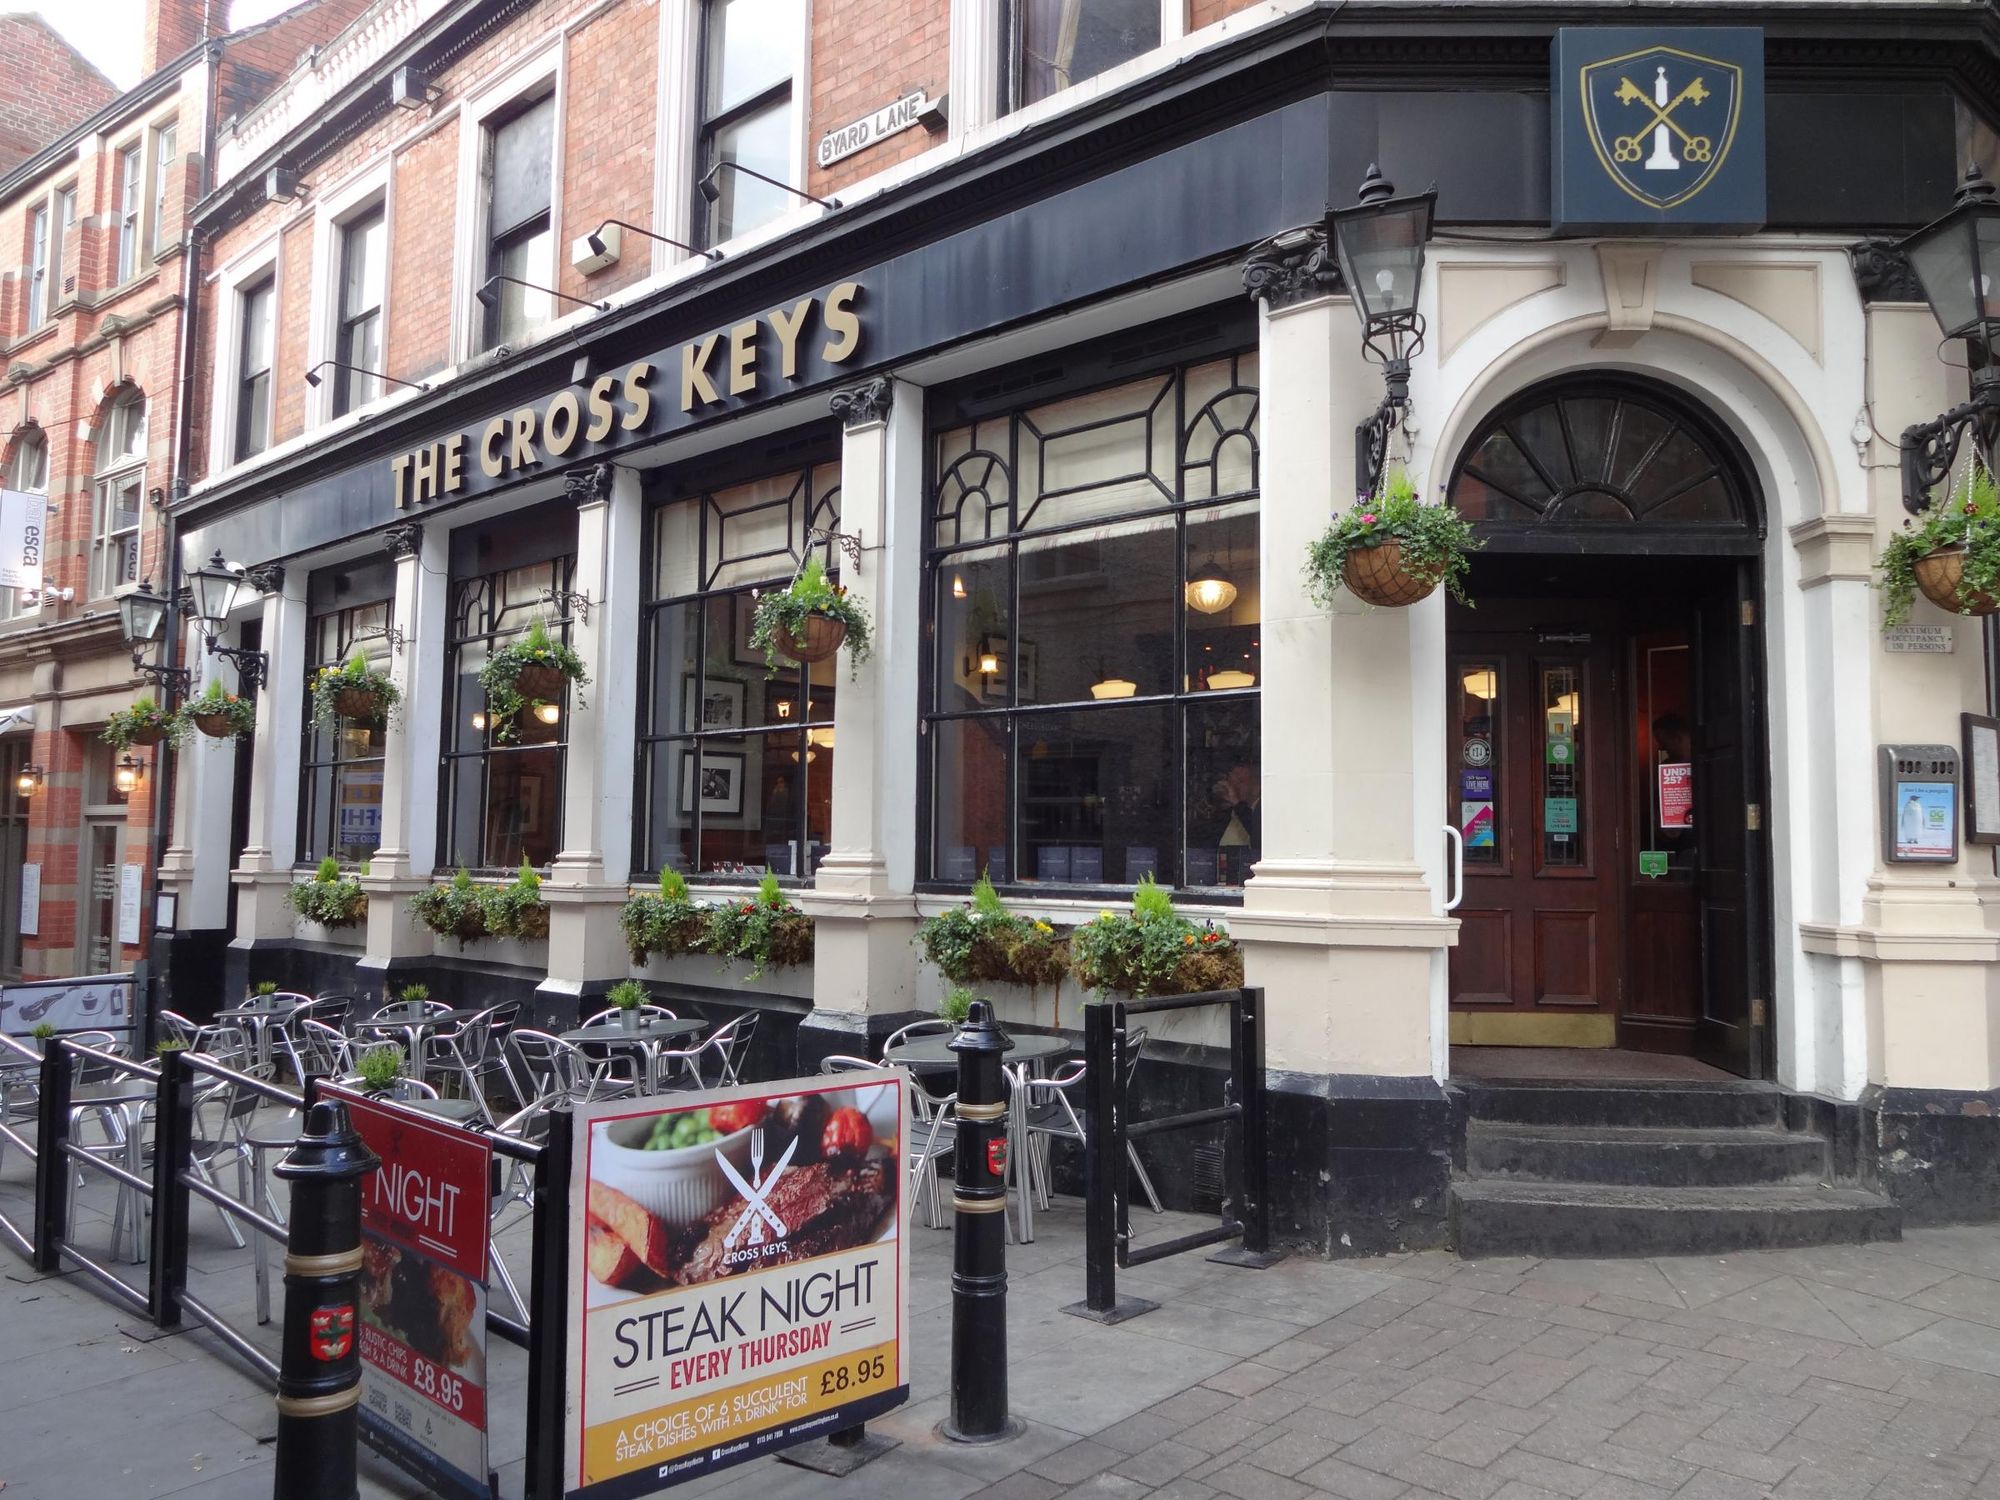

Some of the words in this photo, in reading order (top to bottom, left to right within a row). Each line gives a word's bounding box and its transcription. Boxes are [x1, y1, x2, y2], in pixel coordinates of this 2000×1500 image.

[822, 122, 869, 161] BYARD
[875, 96, 921, 136] LANE
[391, 433, 466, 510] THE
[480, 362, 656, 479] CROSS
[681, 282, 865, 413] KEYS
[1891, 634, 1946, 642] OCCUPANCY
[1908, 642, 1947, 650] PERSONS
[1663, 776, 1682, 785] 25?
[374, 1163, 460, 1237] NIGHT
[723, 1247, 759, 1265] CROSS
[762, 1241, 787, 1257] KEYS
[613, 1291, 747, 1369] STEAK
[760, 1260, 878, 1331] NIGHT
[387, 1356, 408, 1380] DRINK
[388, 1342, 408, 1364] CHIPS
[670, 1346, 732, 1390] EVERY
[738, 1320, 832, 1370] THURSDAY
[820, 1355, 885, 1396] £8.95
[414, 1358, 463, 1411] £8.95
[616, 1430, 628, 1447] A
[633, 1410, 690, 1441] CHOICE
[695, 1403, 715, 1423] OF
[719, 1400, 728, 1416] 6
[733, 1376, 808, 1412] SUCCULENT
[616, 1439, 653, 1462] STEAK
[657, 1426, 697, 1449] DISHES
[701, 1415, 730, 1435] WITH
[733, 1413, 742, 1426] A
[786, 1392, 807, 1410] FOR
